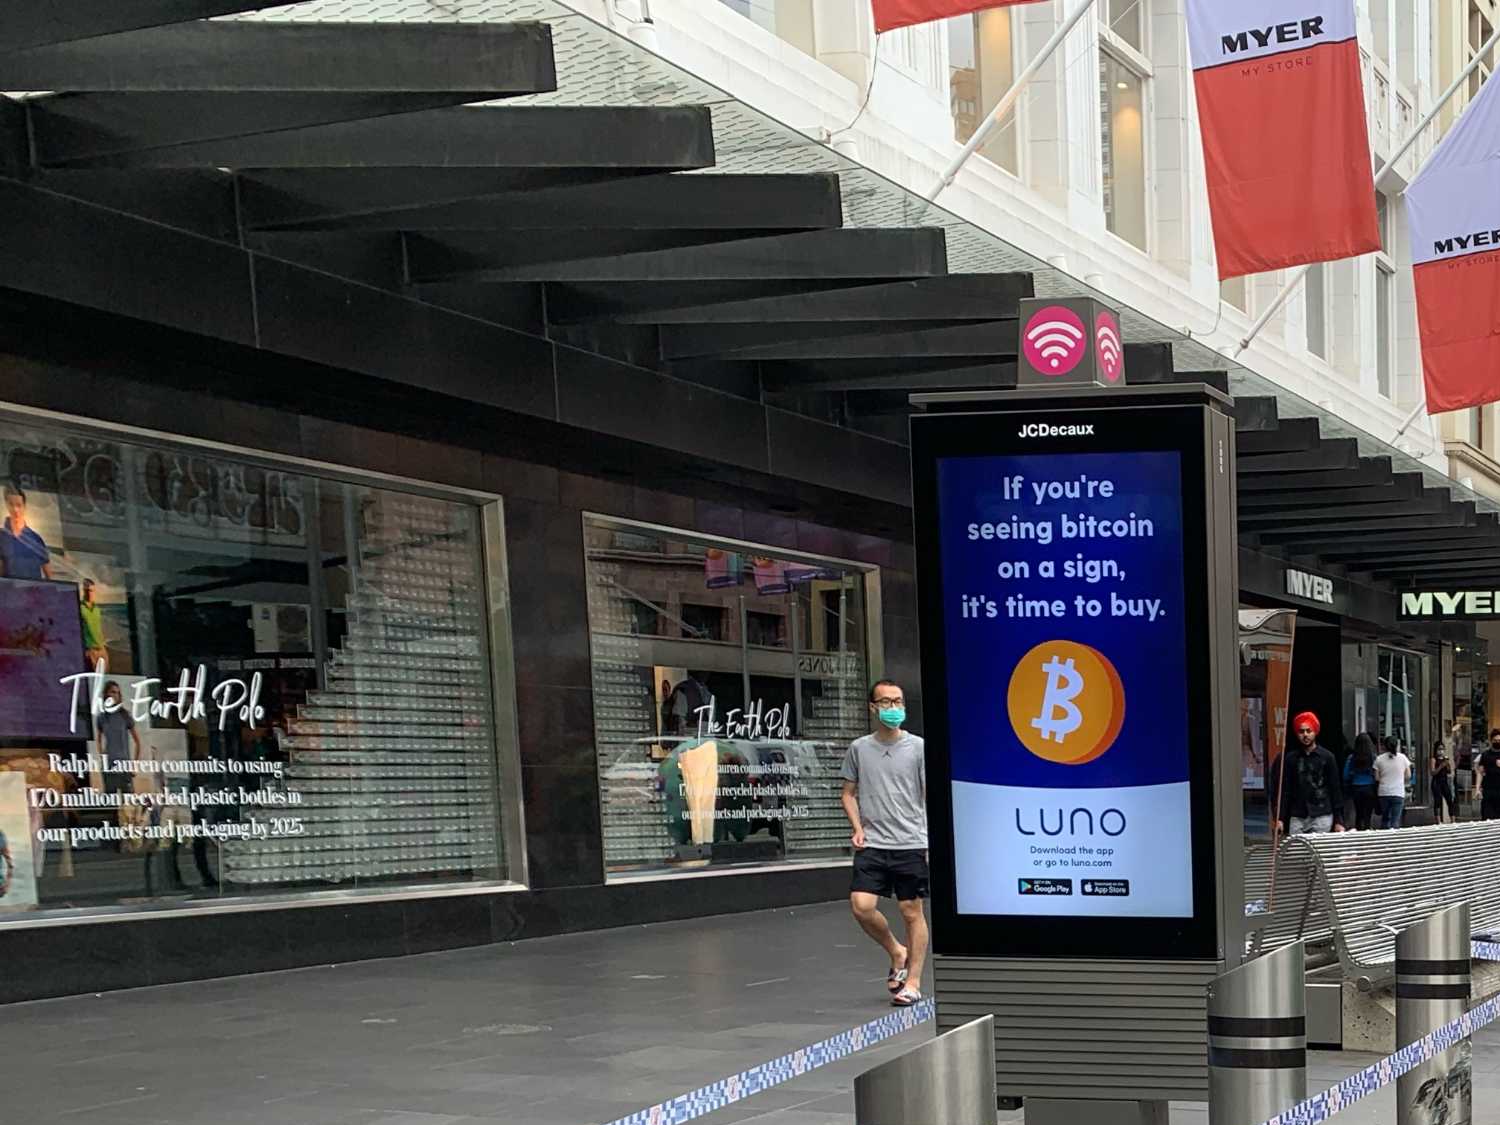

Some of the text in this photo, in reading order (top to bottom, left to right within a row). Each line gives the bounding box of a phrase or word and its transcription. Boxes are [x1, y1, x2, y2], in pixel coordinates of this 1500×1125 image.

[1221, 15, 1325, 55] MYER
[1241, 55, 1314, 78] MY STORE
[1018, 423, 1095, 438] JCDecaux
[1003, 474, 1114, 505] If you're
[967, 512, 1154, 544] seeing bitcoin
[998, 553, 1126, 583] on a sign,
[1286, 568, 1334, 603] MYER
[962, 592, 1166, 622] it's time to buy.
[60, 657, 265, 734] The Earth Polo
[693, 694, 790, 745] The Earth Polo
[49, 753, 283, 779] Ralph Lauren commits to using
[740, 761, 772, 774] commits
[771, 762, 779, 774] to
[778, 764, 799, 777] using
[61, 787, 120, 807] million
[123, 787, 189, 810] recycled
[190, 787, 238, 810] plastic
[239, 786, 286, 806] bottles
[287, 787, 302, 805] in
[722, 783, 752, 800] recycled
[753, 783, 776, 800] plastic
[777, 782, 800, 796] bottles
[731, 805, 746, 818] and
[746, 805, 783, 821] packaging
[783, 806, 791, 821] by
[37, 817, 304, 847] our products and packaging by 2025
[1030, 846, 1114, 856] Download the app
[1033, 858, 1112, 868] or go to luno.com
[1033, 884, 1070, 895] Google Play
[1094, 885, 1127, 895] App Store
